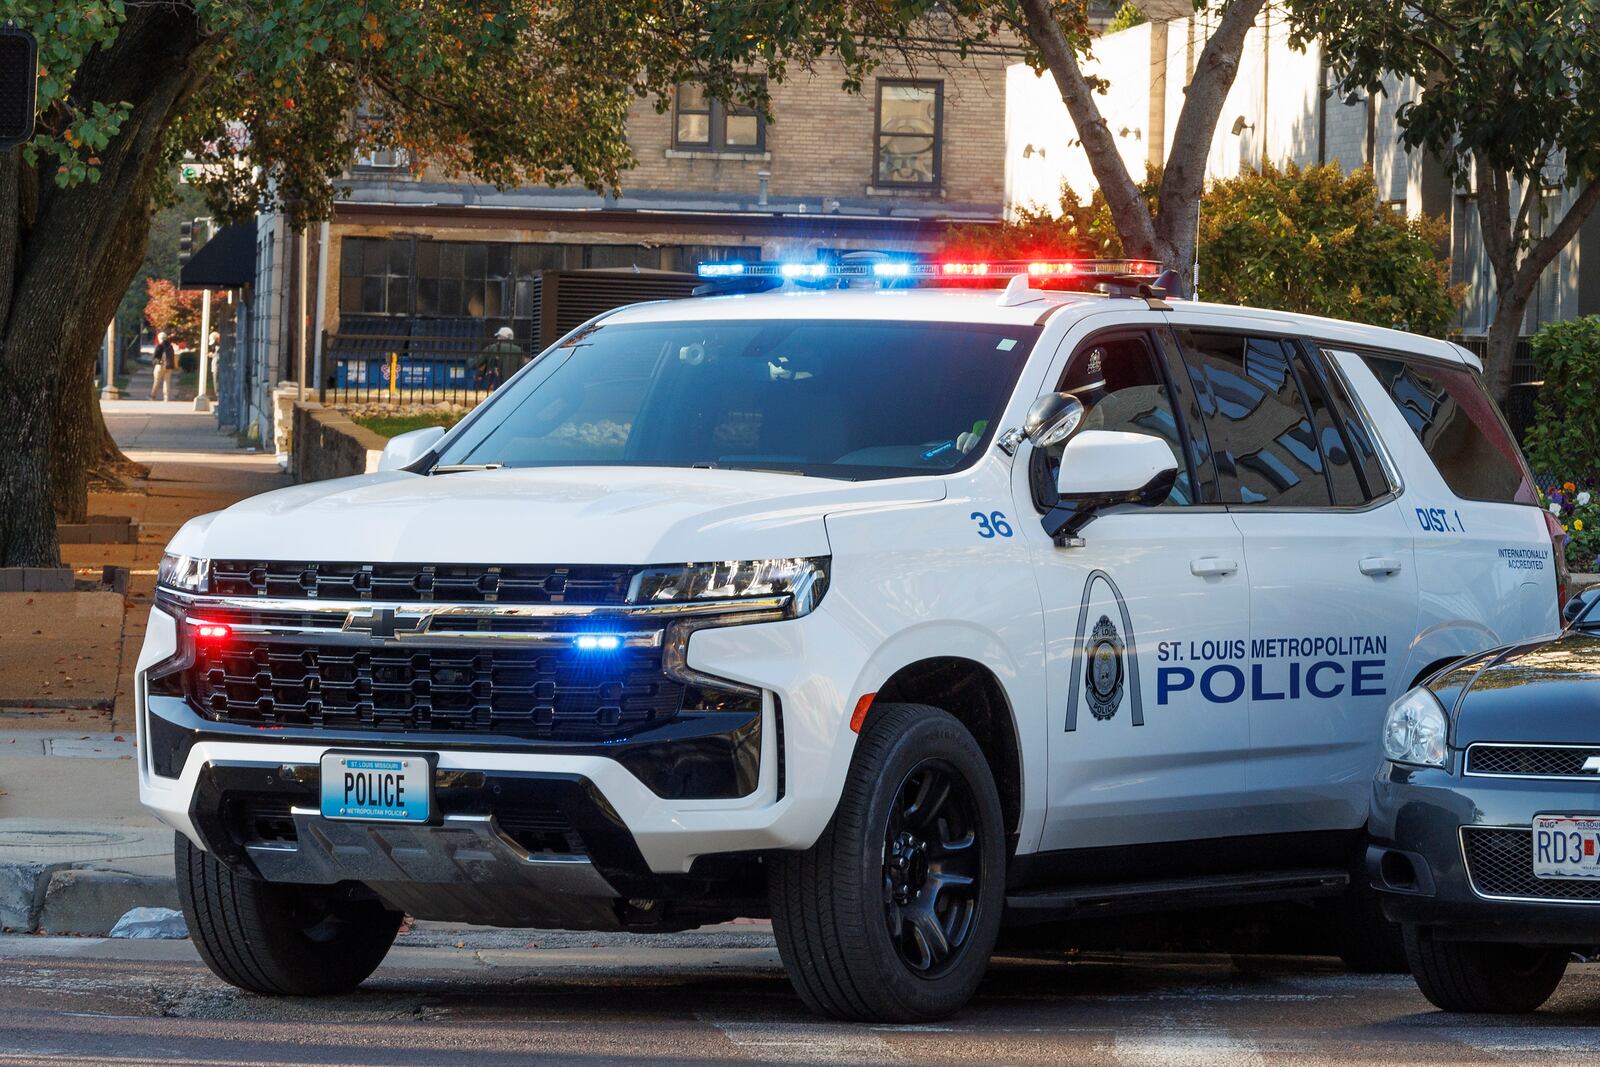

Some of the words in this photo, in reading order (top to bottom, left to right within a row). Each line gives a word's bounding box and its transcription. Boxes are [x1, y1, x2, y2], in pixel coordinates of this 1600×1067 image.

[970, 510, 1014, 539] 36
[1415, 507, 1456, 533] DIST.
[1454, 509, 1466, 533] 1
[1498, 548, 1549, 560] INTERNATIONALLY
[1508, 559, 1544, 570] ACCREDITED
[1157, 641, 1184, 662] ST.
[1190, 639, 1246, 661] LOUIS
[1251, 635, 1387, 659] METROPOLITAN
[1156, 659, 1387, 706] POLICE
[1093, 701, 1116, 714] POLICE
[374, 762, 399, 770] MISSOURI
[344, 772, 405, 808] POLICE
[346, 808, 384, 816] METROPOLITAN
[1539, 821, 1555, 829] AUG
